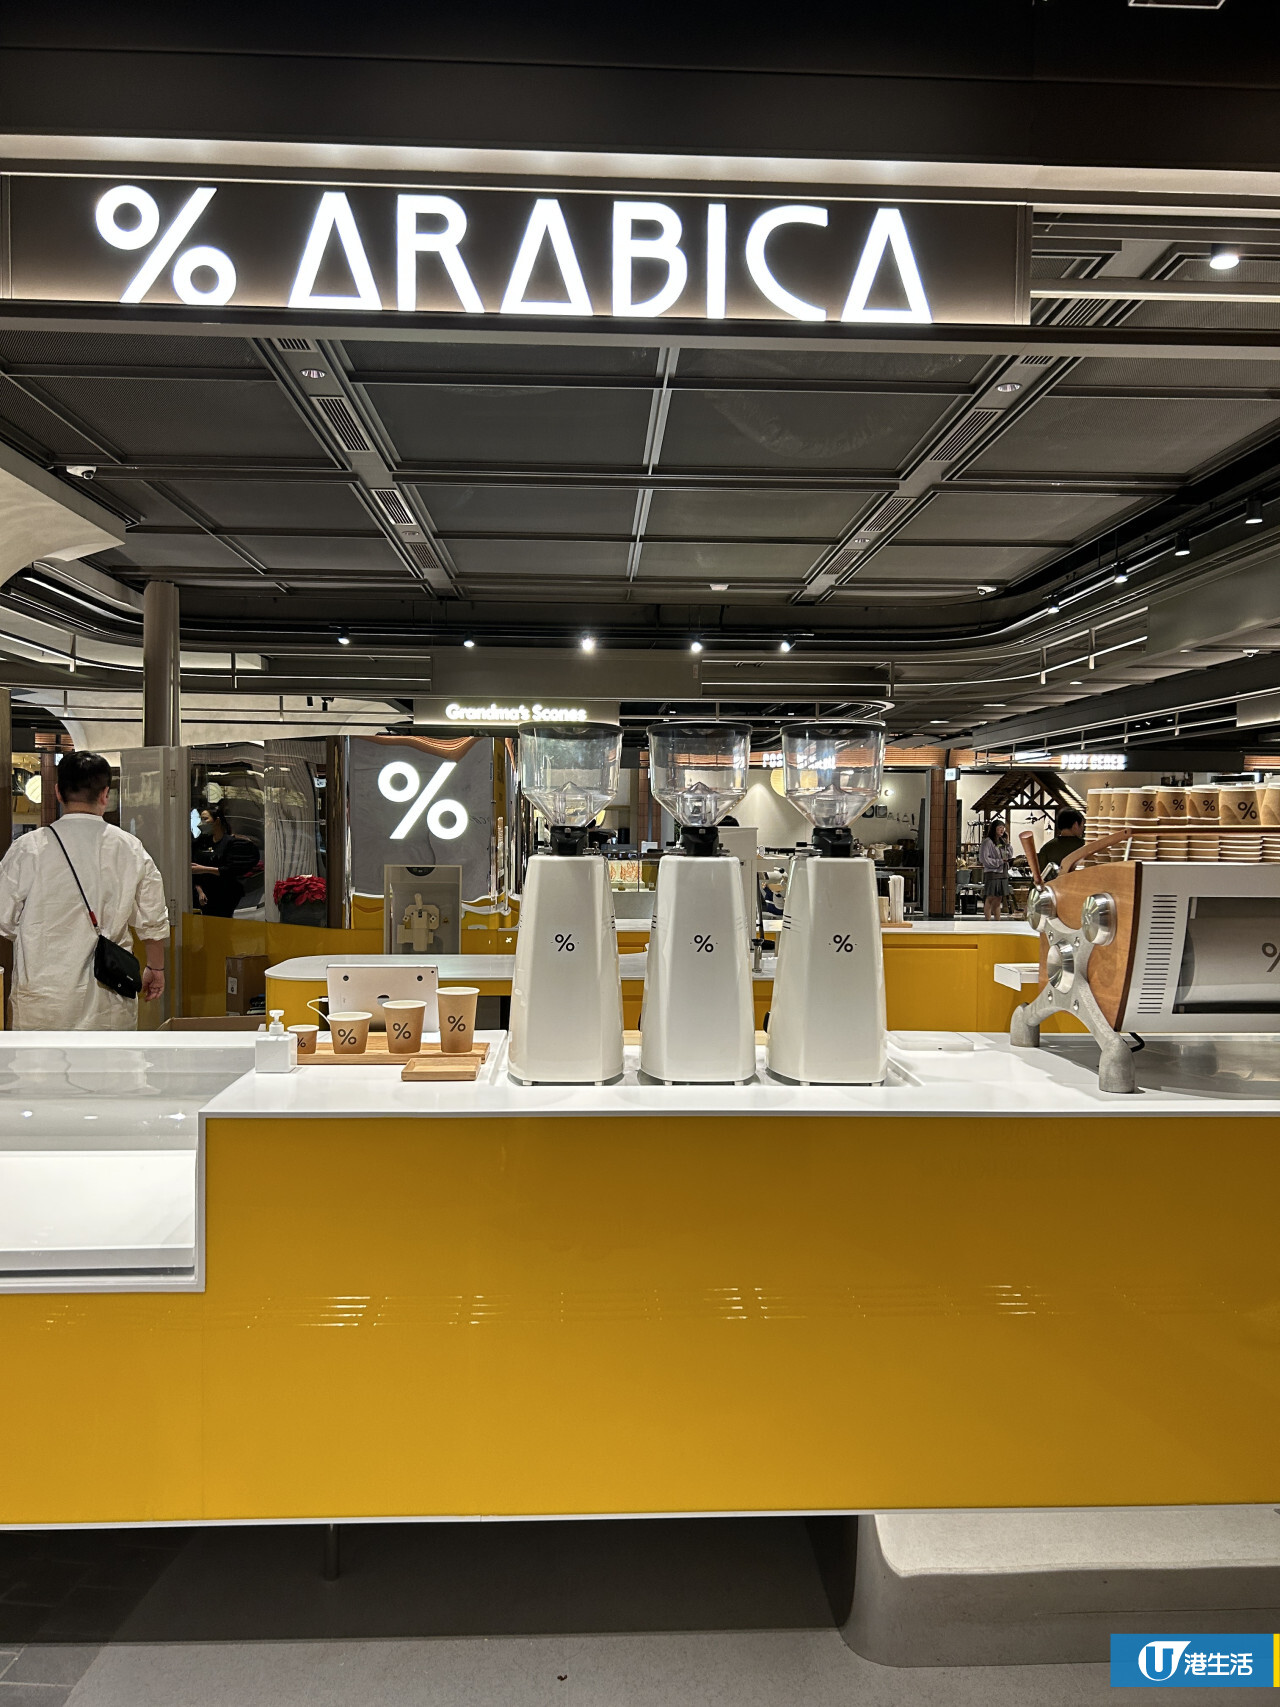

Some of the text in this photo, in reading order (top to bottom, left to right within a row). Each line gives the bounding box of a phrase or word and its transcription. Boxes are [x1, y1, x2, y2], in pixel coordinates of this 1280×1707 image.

[94, 185, 934, 325] % ARABICA
[446, 703, 587, 721] Grandma's Scones
[377, 761, 468, 840] %
[1142, 800, 1155, 813] %
[1172, 799, 1185, 811] %
[1202, 800, 1216, 812] %
[1237, 801, 1258, 820] %
[554, 934, 575, 952] %
[693, 935, 714, 953] %
[832, 935, 854, 953] %
[392, 1022, 412, 1040] %
[447, 1015, 467, 1033] %
[337, 1028, 357, 1045] %
